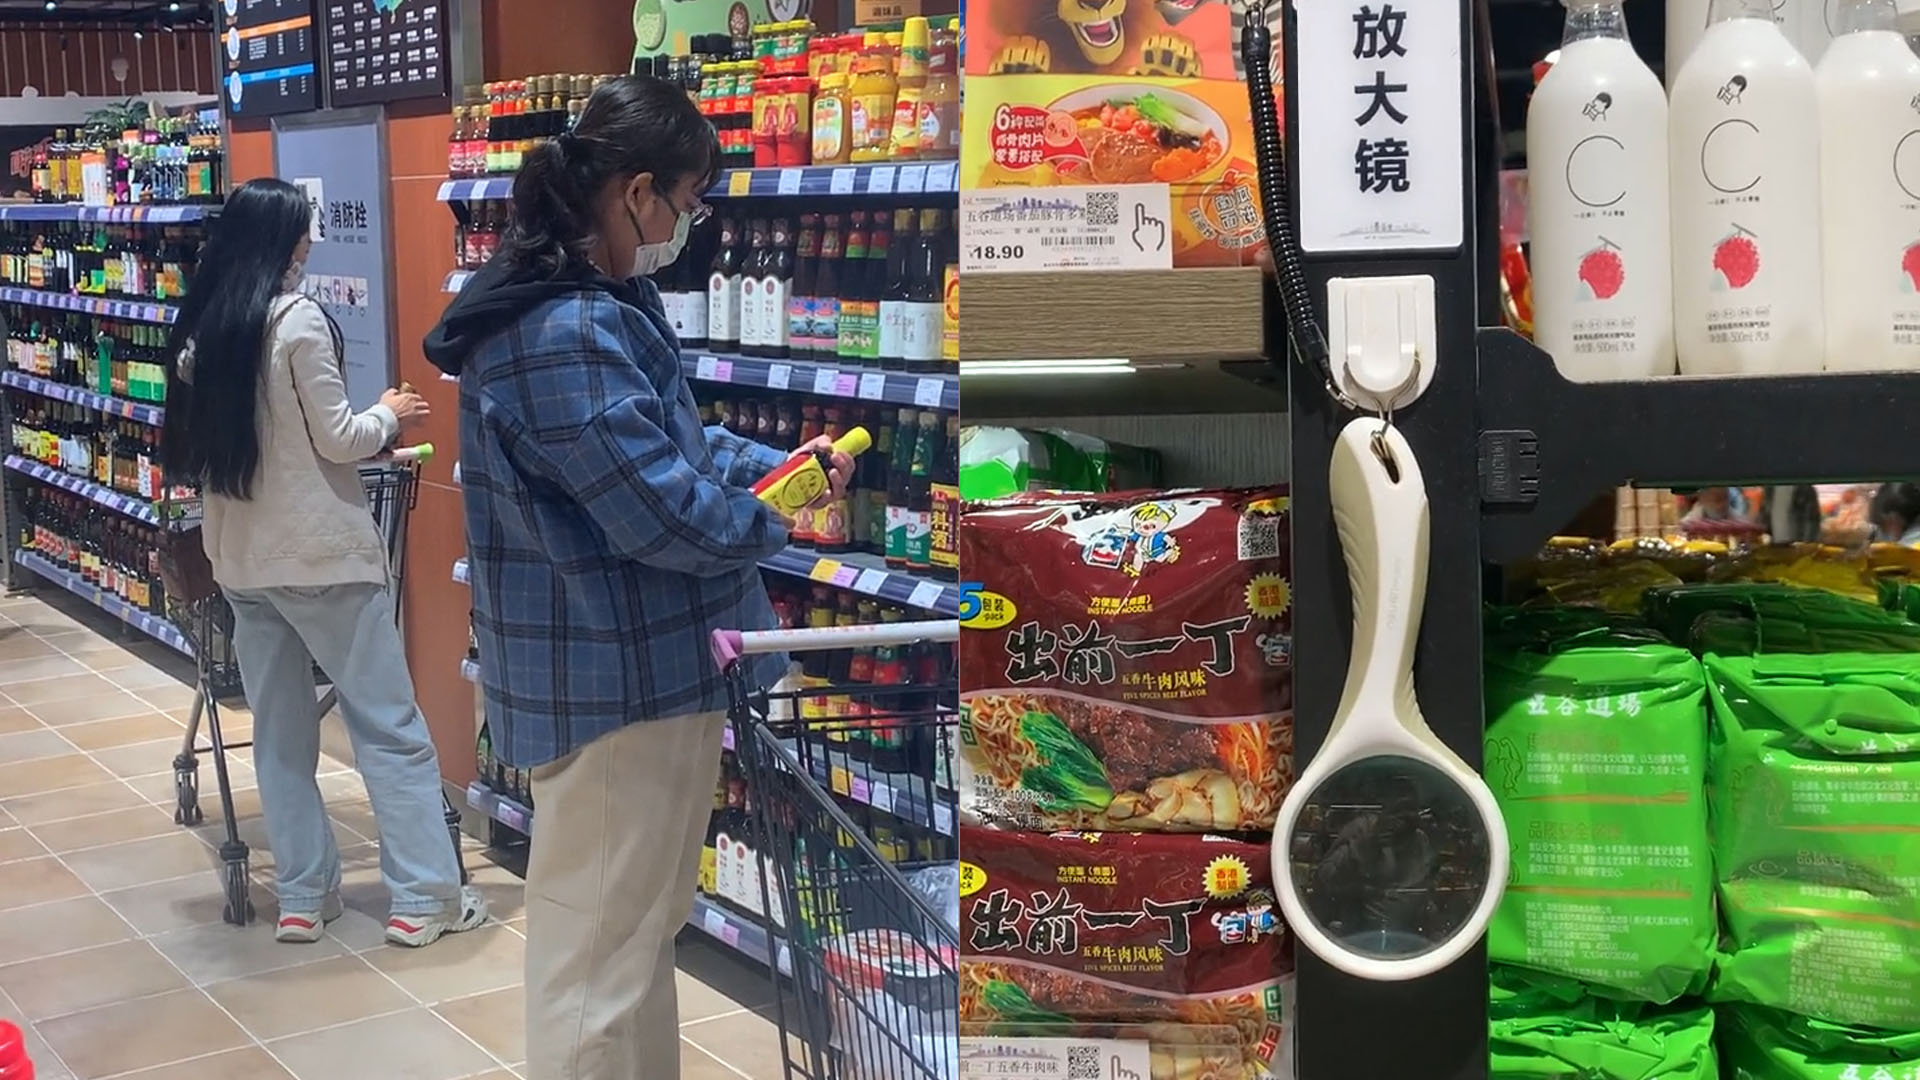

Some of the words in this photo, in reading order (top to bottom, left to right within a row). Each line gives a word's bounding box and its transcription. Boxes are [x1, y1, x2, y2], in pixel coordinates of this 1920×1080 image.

[1352, 4, 1410, 194] 放大镜
[330, 200, 368, 229] 消防栓
[1004, 614, 1252, 685] 出前一丁
[1122, 668, 1207, 691] 五香牛肉风味
[1056, 876, 1087, 884] INSTANT
[1088, 876, 1118, 885] NOODLE
[1216, 868, 1237, 879] 香港
[970, 888, 1208, 956] 出前一丁
[1083, 945, 1164, 963] 五香牛肉风味
